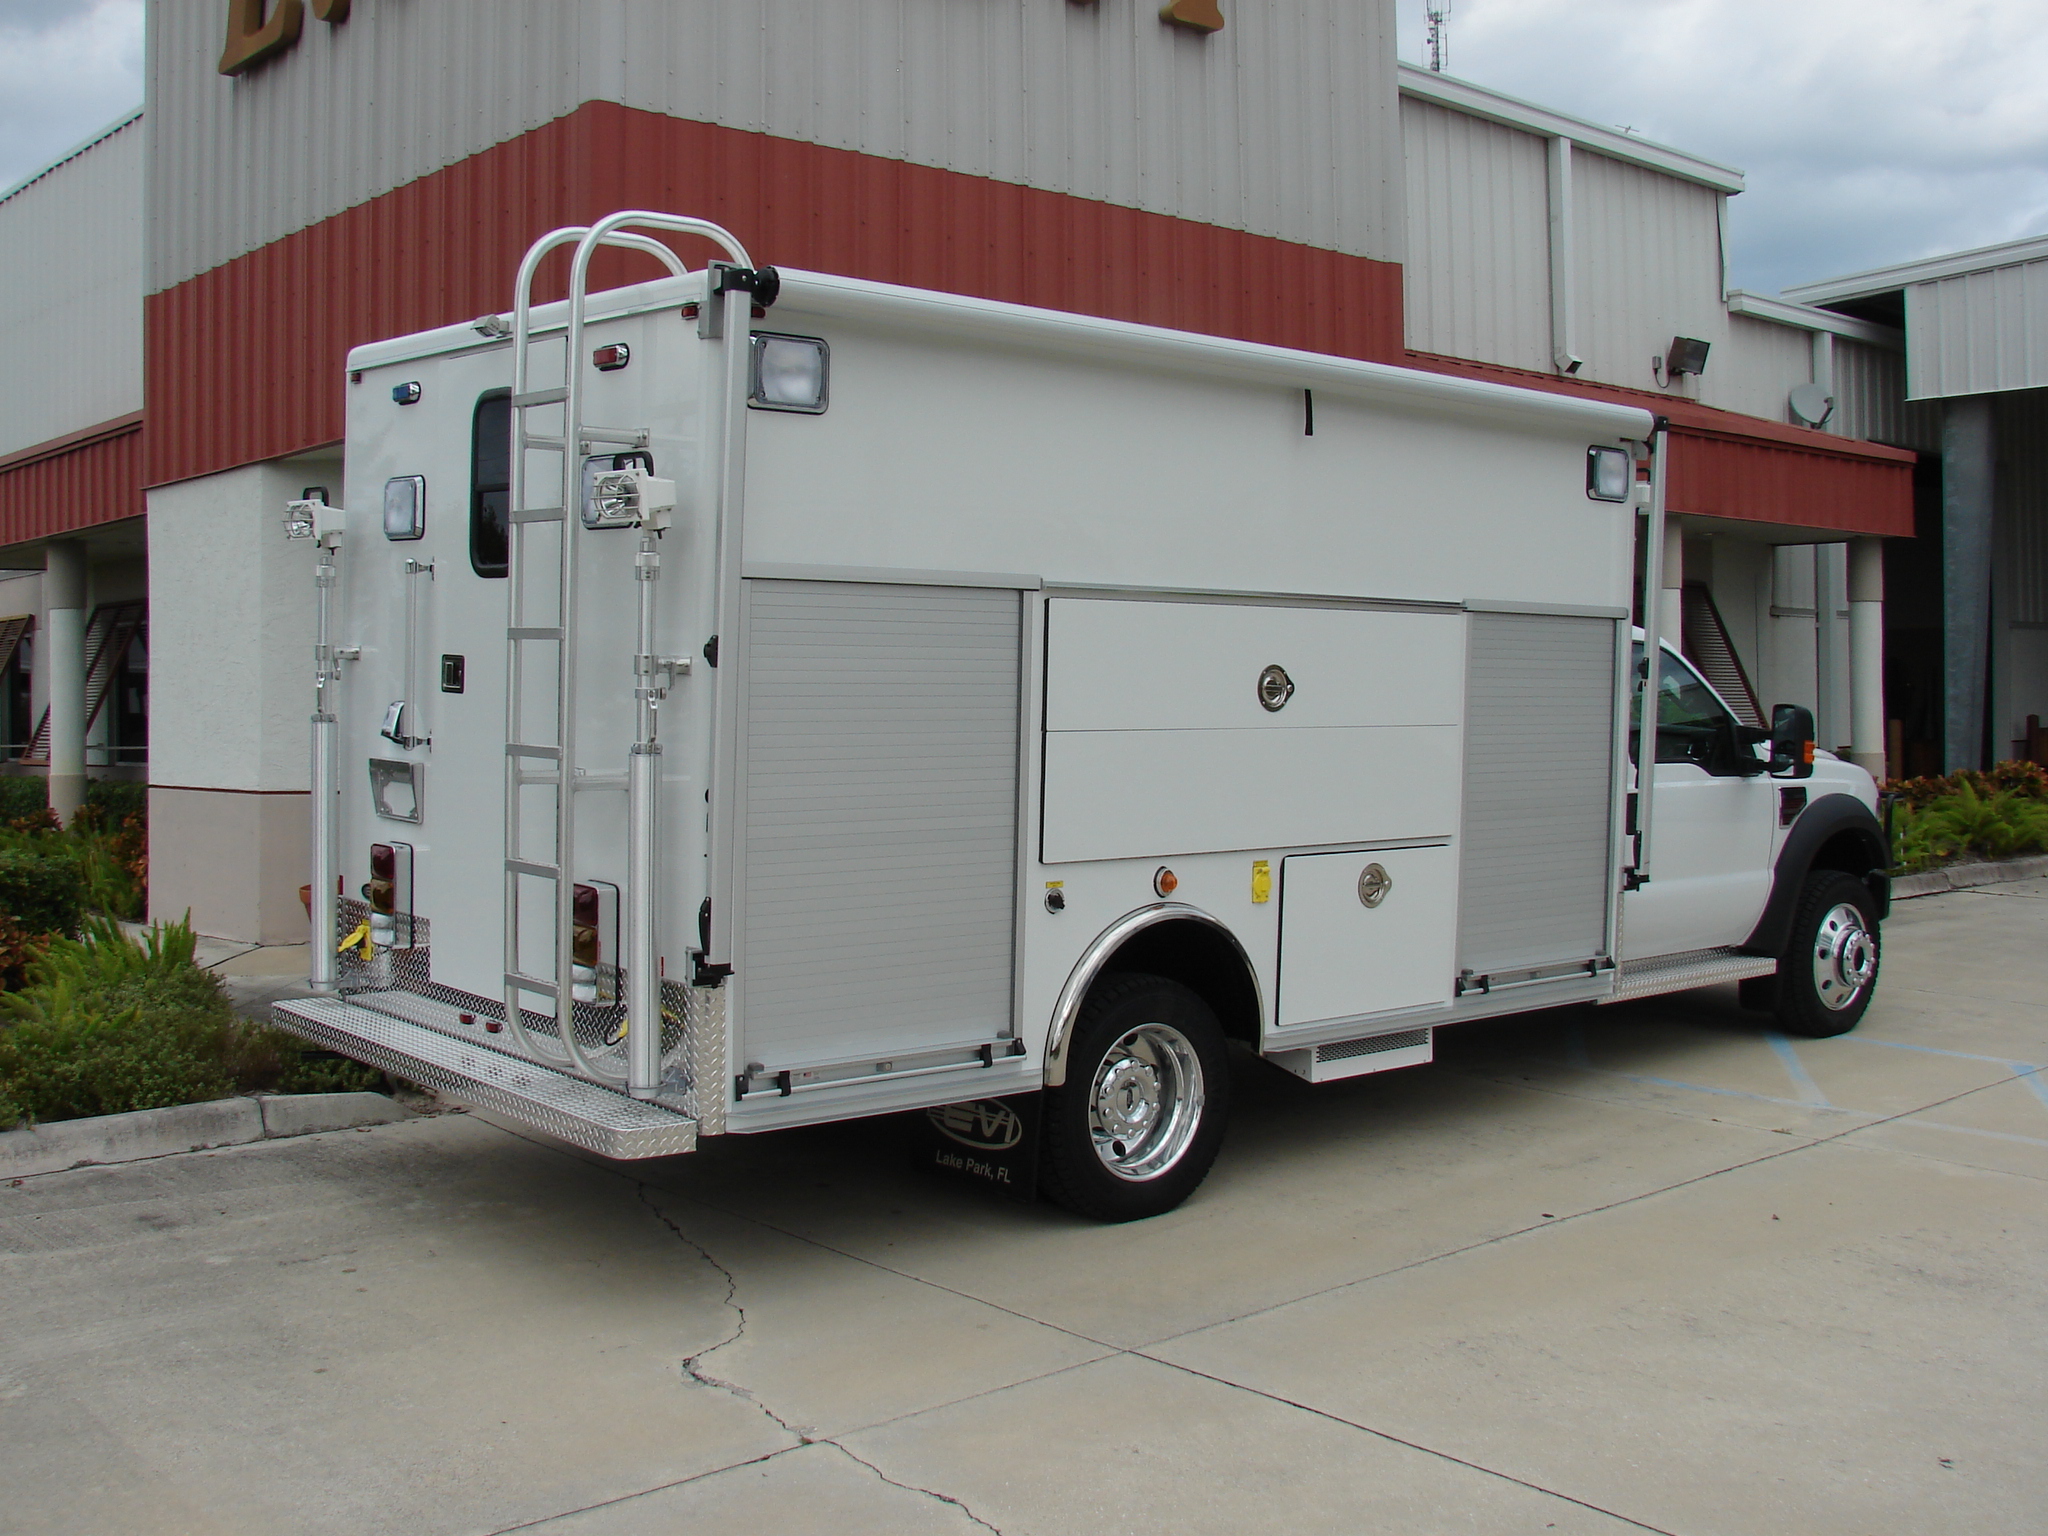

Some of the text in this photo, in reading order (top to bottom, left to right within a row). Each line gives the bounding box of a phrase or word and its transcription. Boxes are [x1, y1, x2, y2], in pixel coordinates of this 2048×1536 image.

[935, 1150, 1011, 1183] Lake Park, FL
